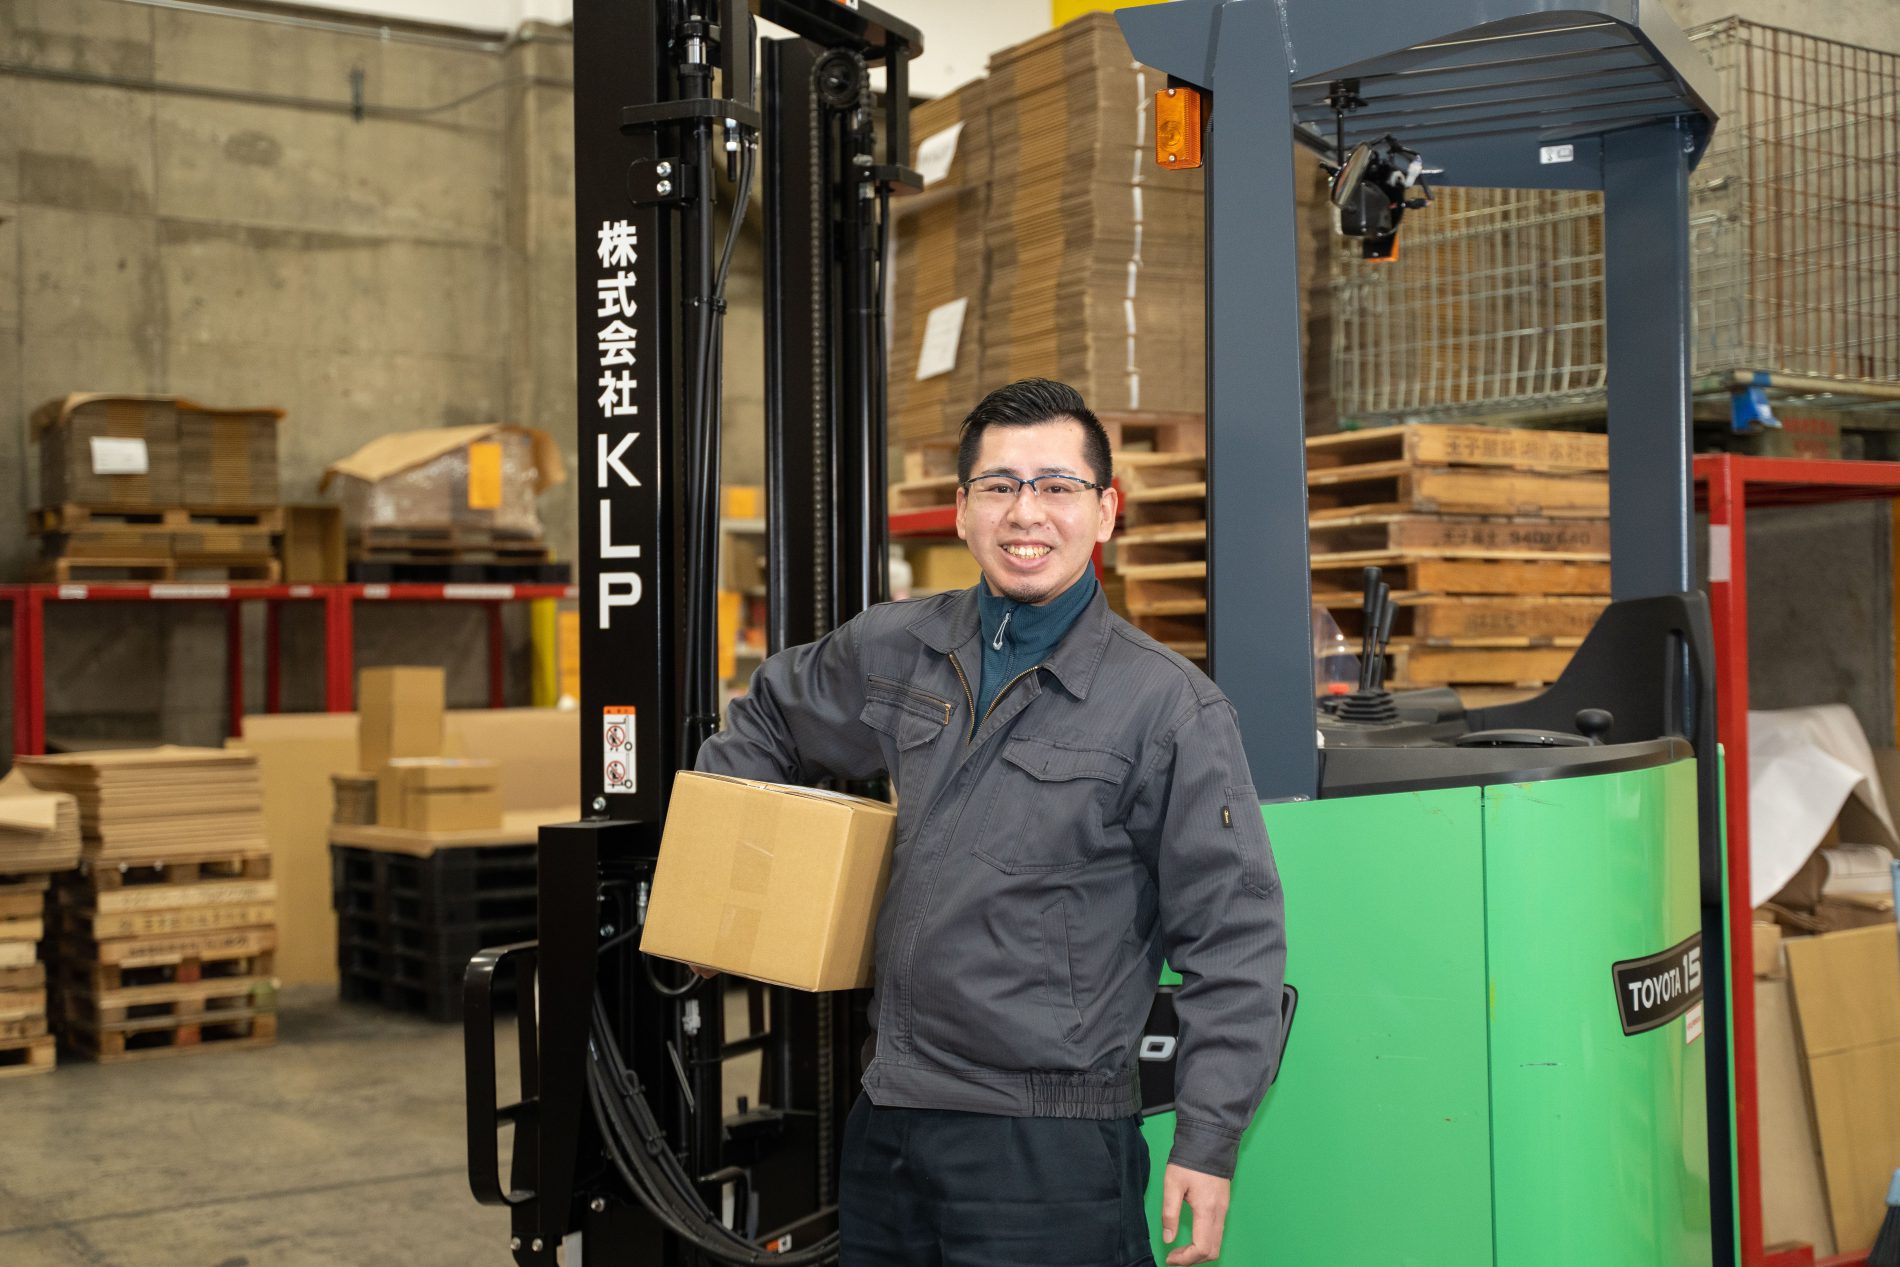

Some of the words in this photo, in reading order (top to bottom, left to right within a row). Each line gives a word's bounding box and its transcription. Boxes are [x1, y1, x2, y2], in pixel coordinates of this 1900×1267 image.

[597, 220, 638, 418] 株式会社
[598, 432, 642, 629] KLP
[1628, 967, 1682, 1012] TOYOTA
[1683, 946, 1701, 994] 15
